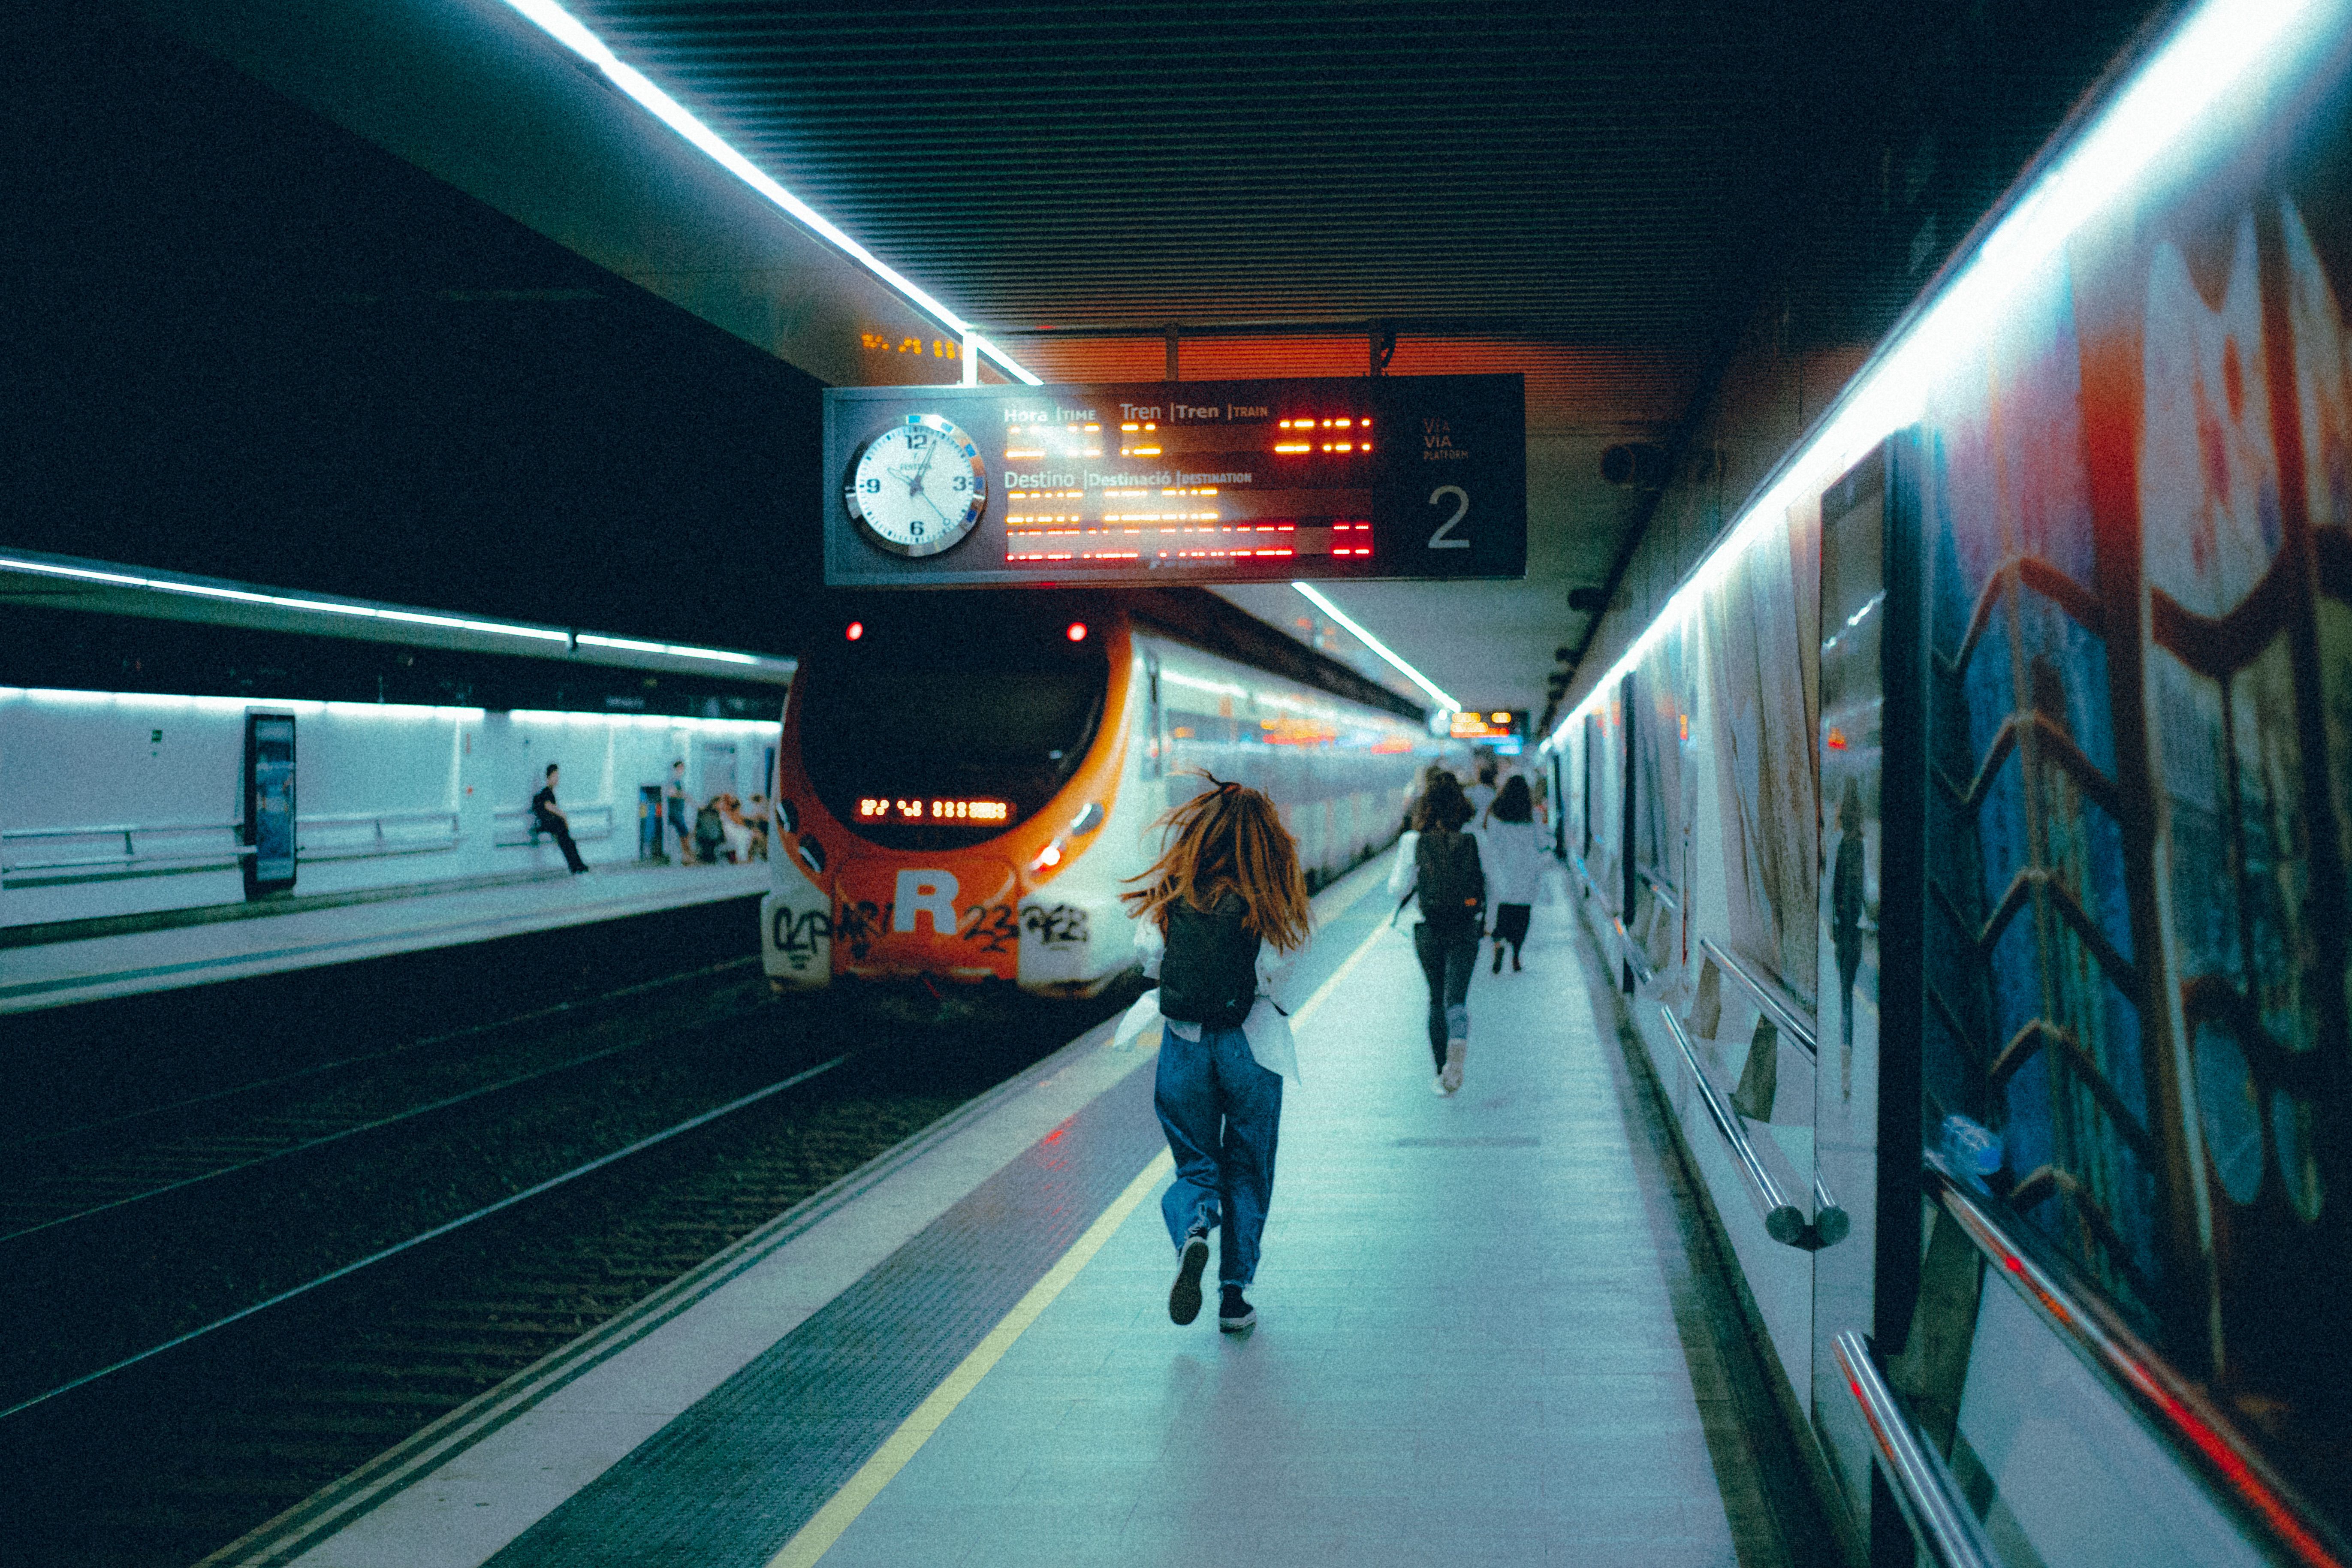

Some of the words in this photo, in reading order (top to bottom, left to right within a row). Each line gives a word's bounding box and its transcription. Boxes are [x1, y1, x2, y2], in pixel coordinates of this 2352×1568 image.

[1004, 409, 1047, 422] Hora
[1061, 410, 1096, 421] TIME
[1119, 403, 1161, 419] Tren
[1176, 404, 1219, 419] Tren
[1233, 406, 1268, 417] TRAIN
[904, 434, 928, 449] 12
[1423, 449, 1469, 461] PLATFORM
[866, 478, 880, 493] 9
[953, 476, 967, 492] 3
[1004, 471, 1075, 488] Destino
[1089, 470, 1172, 486] Destinació
[1182, 473, 1252, 484] DESTINATION
[1428, 485, 1470, 549] 2
[910, 521, 924, 536] 6
[893, 869, 959, 935] R
